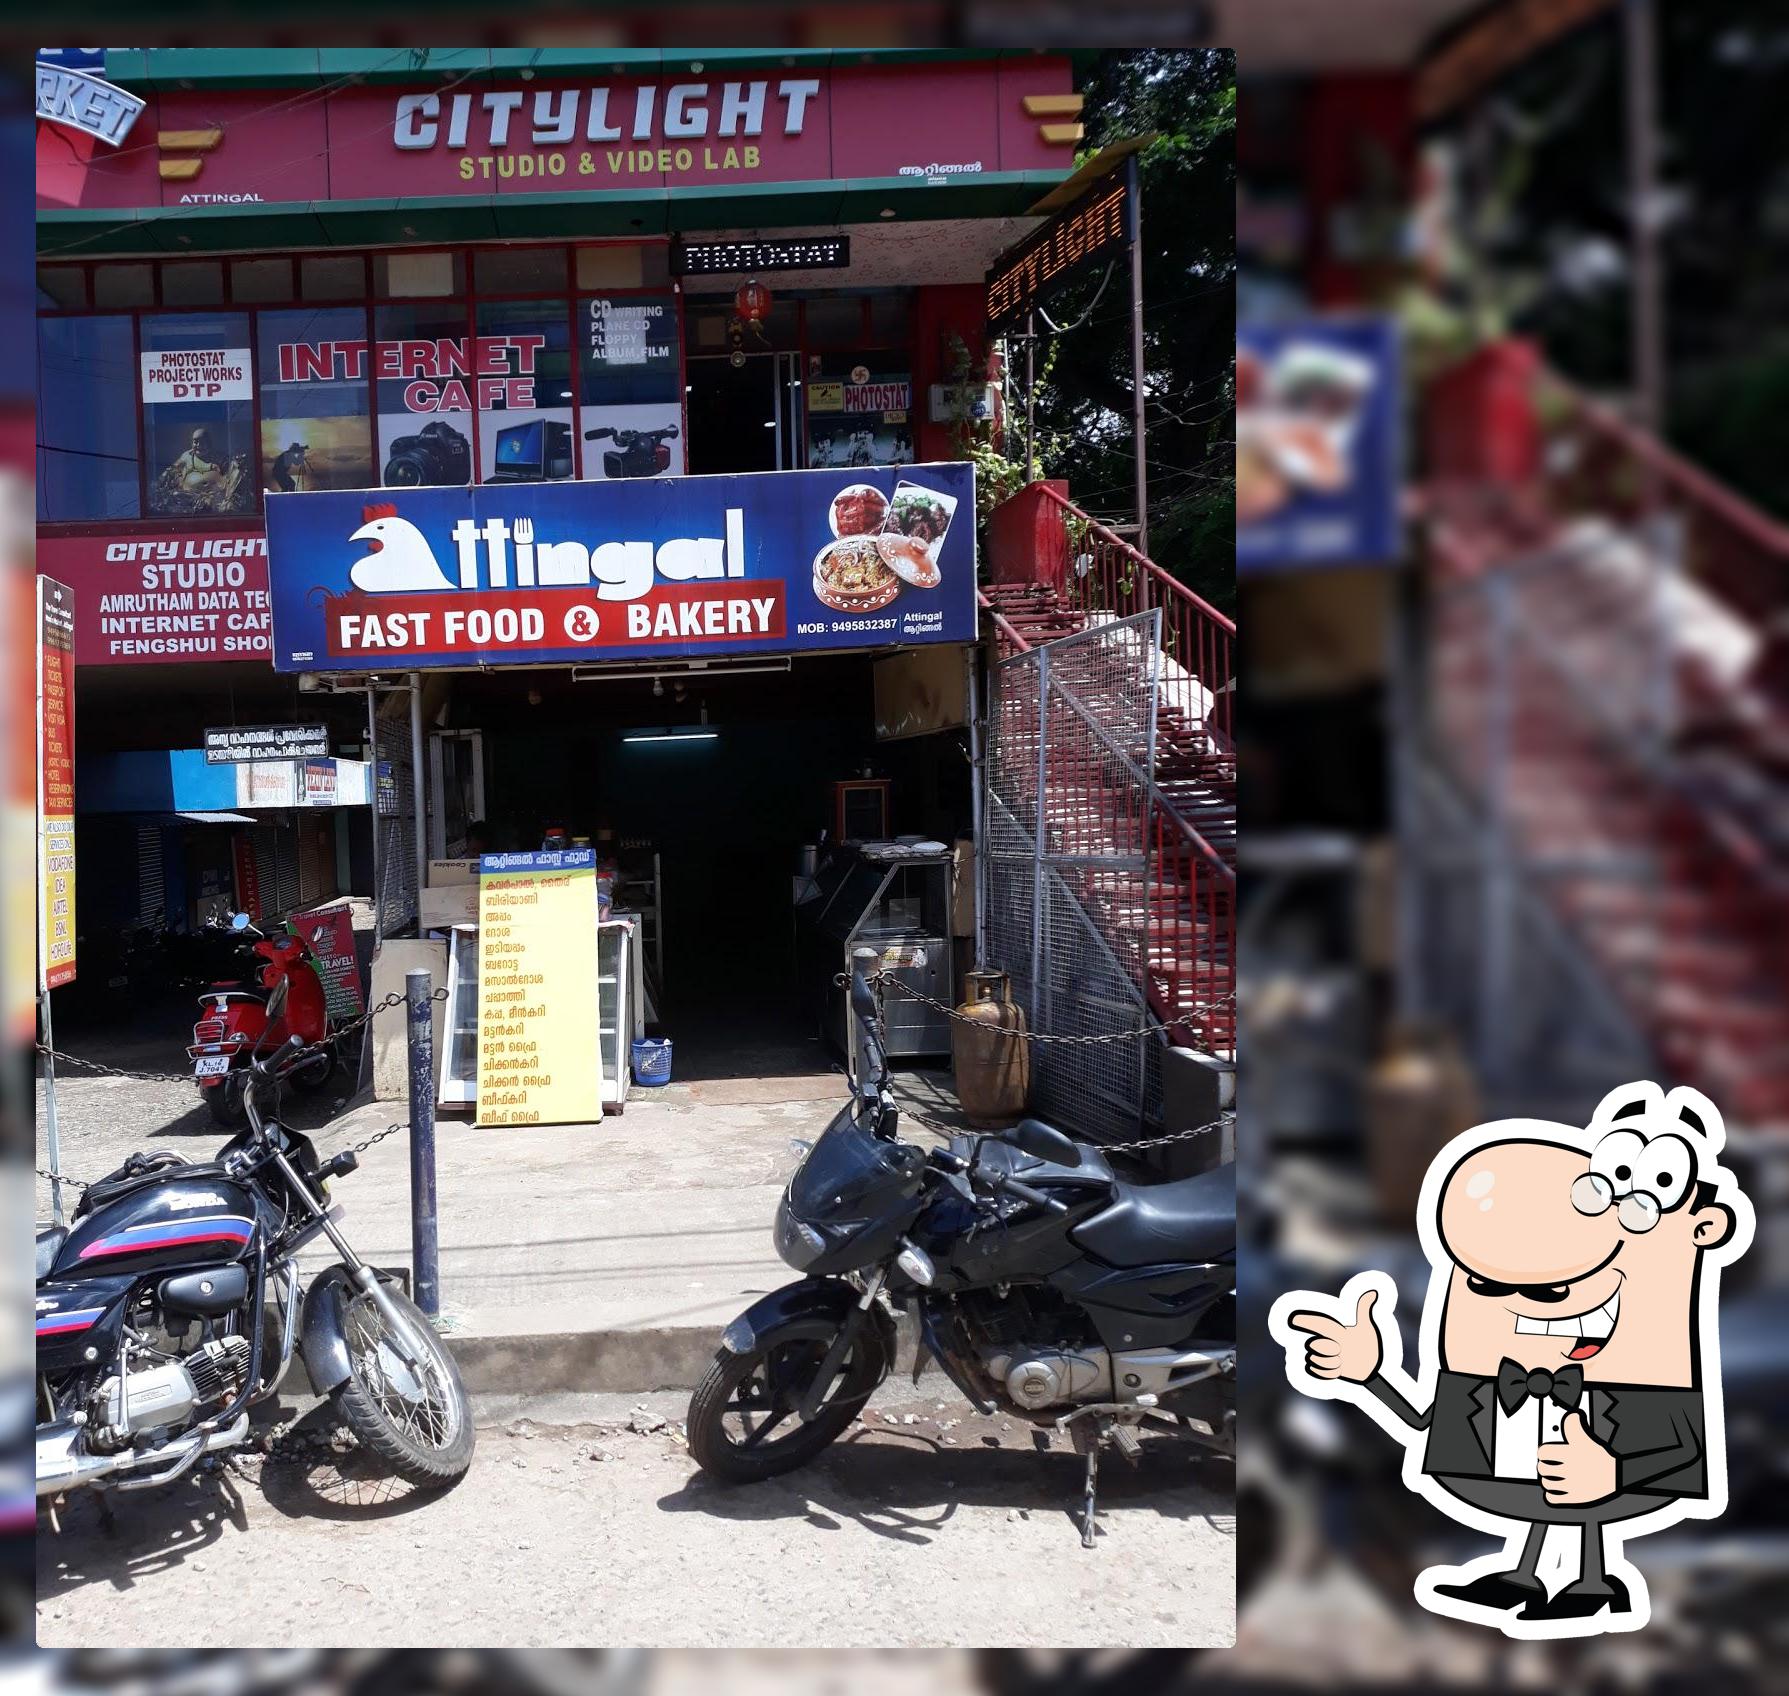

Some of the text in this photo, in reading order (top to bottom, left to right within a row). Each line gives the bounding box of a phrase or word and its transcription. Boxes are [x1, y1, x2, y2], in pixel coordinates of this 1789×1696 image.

[393, 79, 819, 149] CITYLIGHT
[459, 146, 761, 179] STUDIO & VIDEO LAB
[179, 193, 264, 204] ATTINGAL
[591, 300, 664, 319] CD WRITING
[632, 320, 650, 331] CD
[592, 334, 637, 346] FLOPPY
[161, 352, 225, 367] PHOTOSTAT
[279, 335, 545, 382] INTERNET
[643, 346, 669, 358] FILM
[149, 367, 242, 383] PROJECT WORKS
[173, 384, 222, 398] DTP
[404, 378, 536, 414] CAFE
[845, 385, 907, 410] PHOTOSTAT
[106, 541, 178, 561] CITY
[142, 562, 245, 589] STUDIO
[100, 593, 193, 612] AMRUTHAM
[199, 591, 240, 610] DATA
[101, 614, 219, 633] INTERNET
[340, 597, 775, 649] FAST FOOD & BAKERY
[904, 611, 942, 622] Attingal
[797, 618, 898, 635] MOB: 9495832387
[111, 637, 216, 655] FENGSHUI
[321, 955, 354, 970] TRAVEL!
